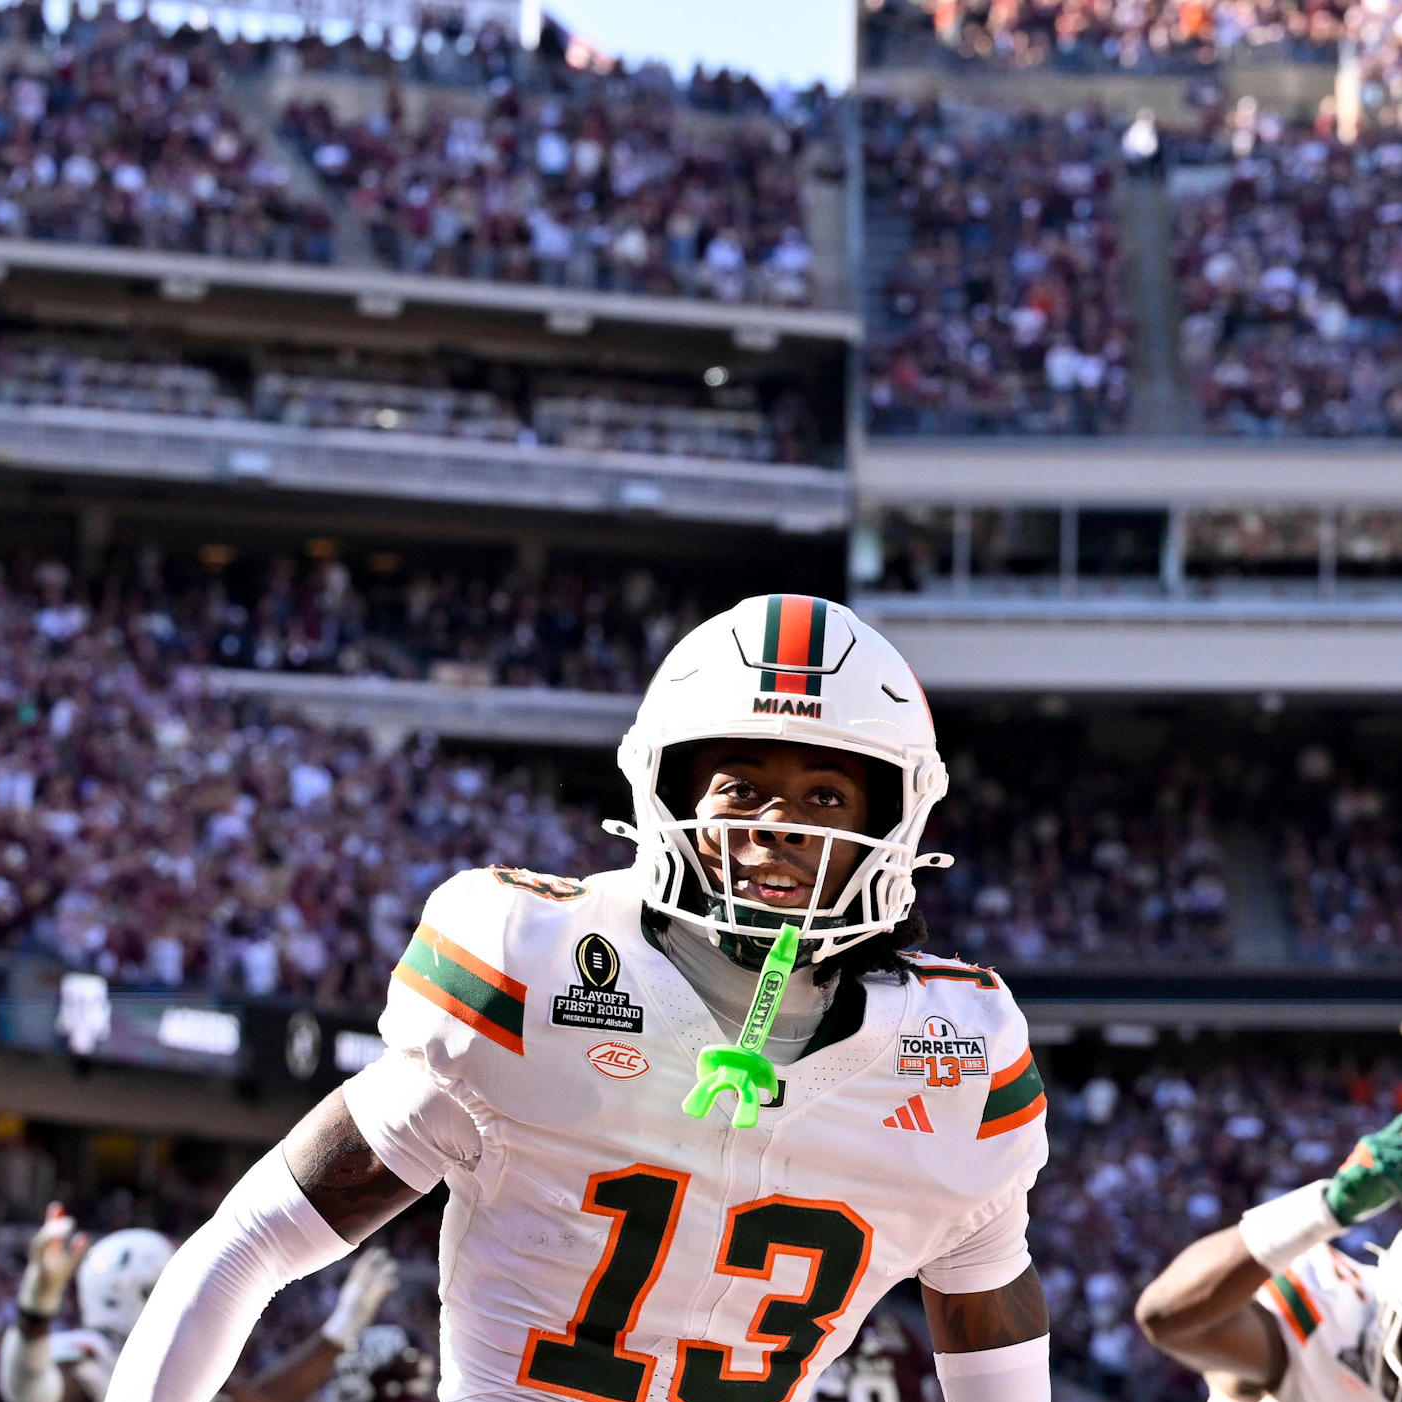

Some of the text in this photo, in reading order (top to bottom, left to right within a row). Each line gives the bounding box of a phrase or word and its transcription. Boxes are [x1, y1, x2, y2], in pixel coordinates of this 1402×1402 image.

[752, 697, 822, 719] MIAMI
[571, 987, 627, 1006] PLAYOFF
[556, 998, 641, 1019] FIRST ROUND
[745, 978, 780, 1046] BATTLE
[562, 1013, 596, 1024] PRESENTED
[604, 1018, 634, 1029] Allstate
[903, 1040, 982, 1055] TORRETTA
[596, 1050, 641, 1068] ACC
[903, 1056, 983, 1087] 1989 13 1992
